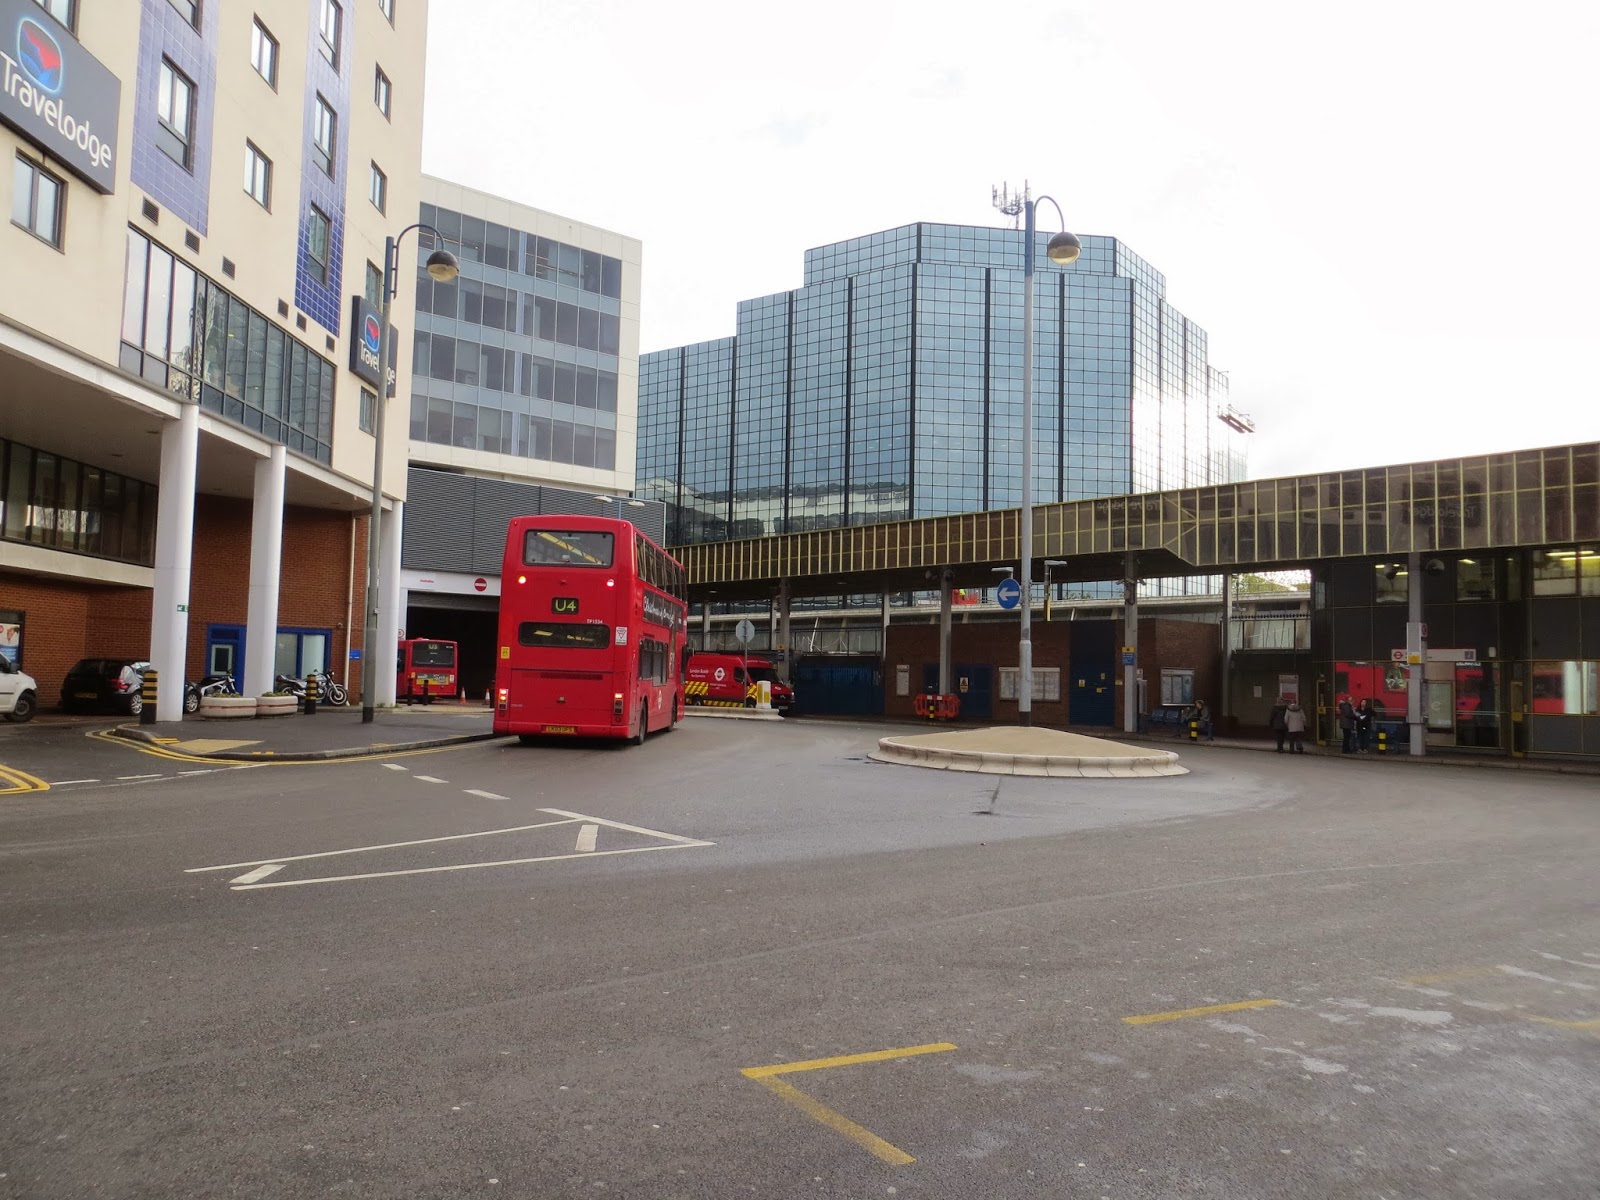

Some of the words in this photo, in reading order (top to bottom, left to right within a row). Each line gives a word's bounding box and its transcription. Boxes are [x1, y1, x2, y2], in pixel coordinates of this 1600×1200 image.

[0, 50, 112, 168] Travelodge
[360, 338, 395, 385] Travelge
[555, 599, 577, 612] U4
